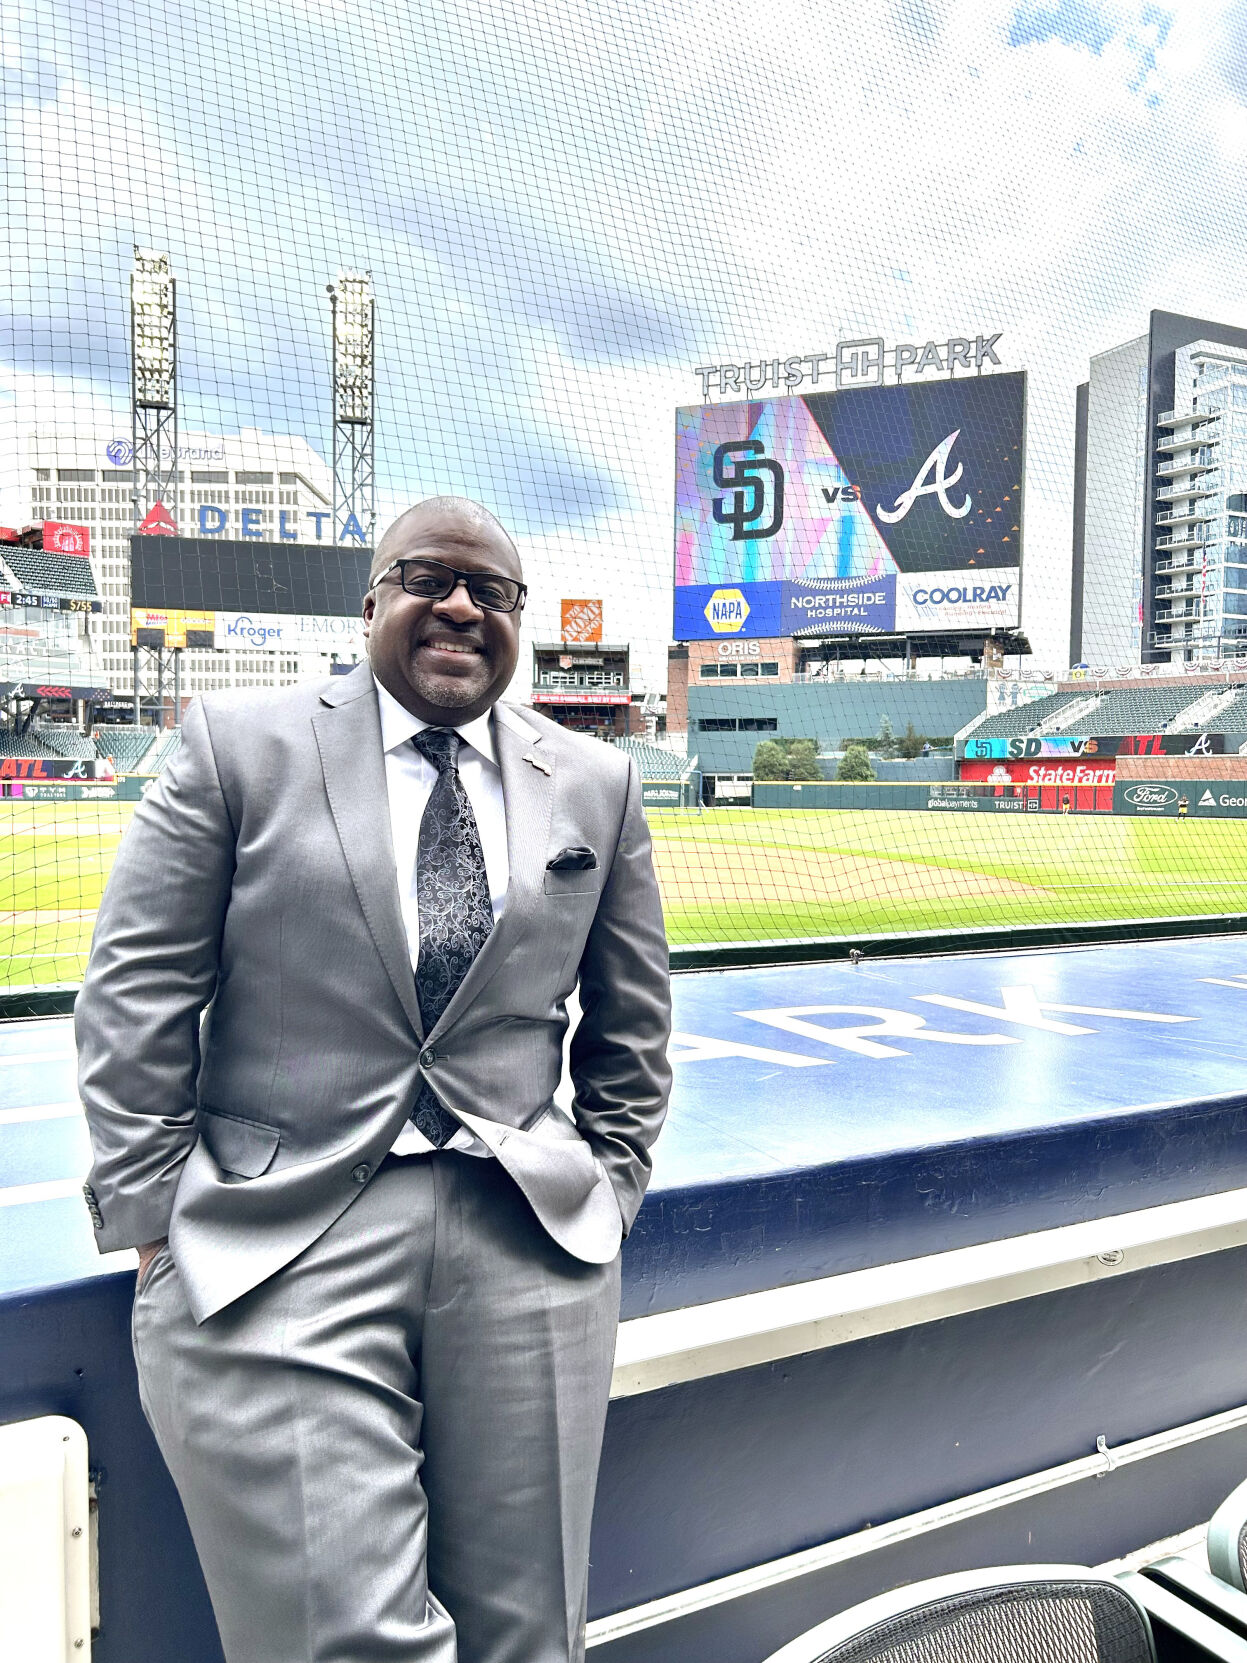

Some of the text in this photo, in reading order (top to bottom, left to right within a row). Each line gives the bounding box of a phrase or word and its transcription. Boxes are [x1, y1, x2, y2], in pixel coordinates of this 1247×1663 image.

[695, 333, 1004, 395] TRUIST PARK
[876, 428, 972, 523] A
[199, 505, 367, 543] DELTA
[16, 595, 38, 606] 2:45
[790, 592, 886, 609] NORTHSIDE
[912, 584, 1013, 606] COOLRAY
[70, 599, 92, 611] $755
[711, 600, 743, 621] NAPA
[807, 607, 868, 618] HOSPITAL
[227, 616, 284, 646] Kroger
[717, 641, 761, 656] ORIS
[1008, 738, 1042, 757] SD
[0, 759, 48, 777] ATL
[1133, 786, 1169, 803] Ford
[994, 801, 1024, 810] TRUIST
